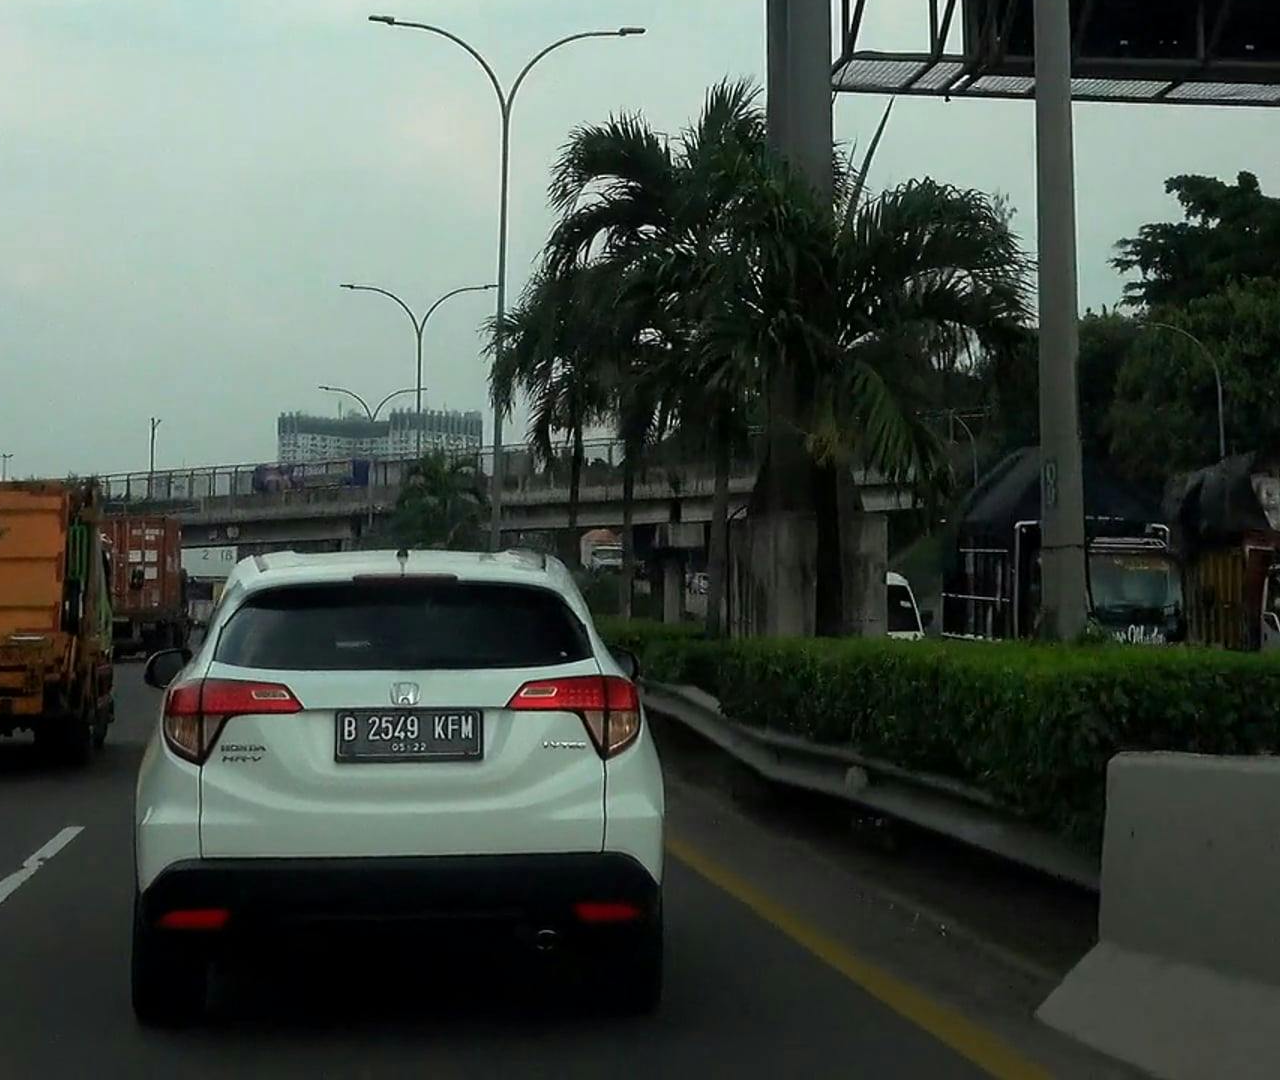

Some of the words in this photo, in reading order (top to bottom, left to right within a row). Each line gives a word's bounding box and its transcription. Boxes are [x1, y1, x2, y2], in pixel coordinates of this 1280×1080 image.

[343, 716, 356, 741] B
[367, 715, 419, 741] 2549
[433, 715, 473, 740] KFM
[220, 744, 267, 752] HONDA
